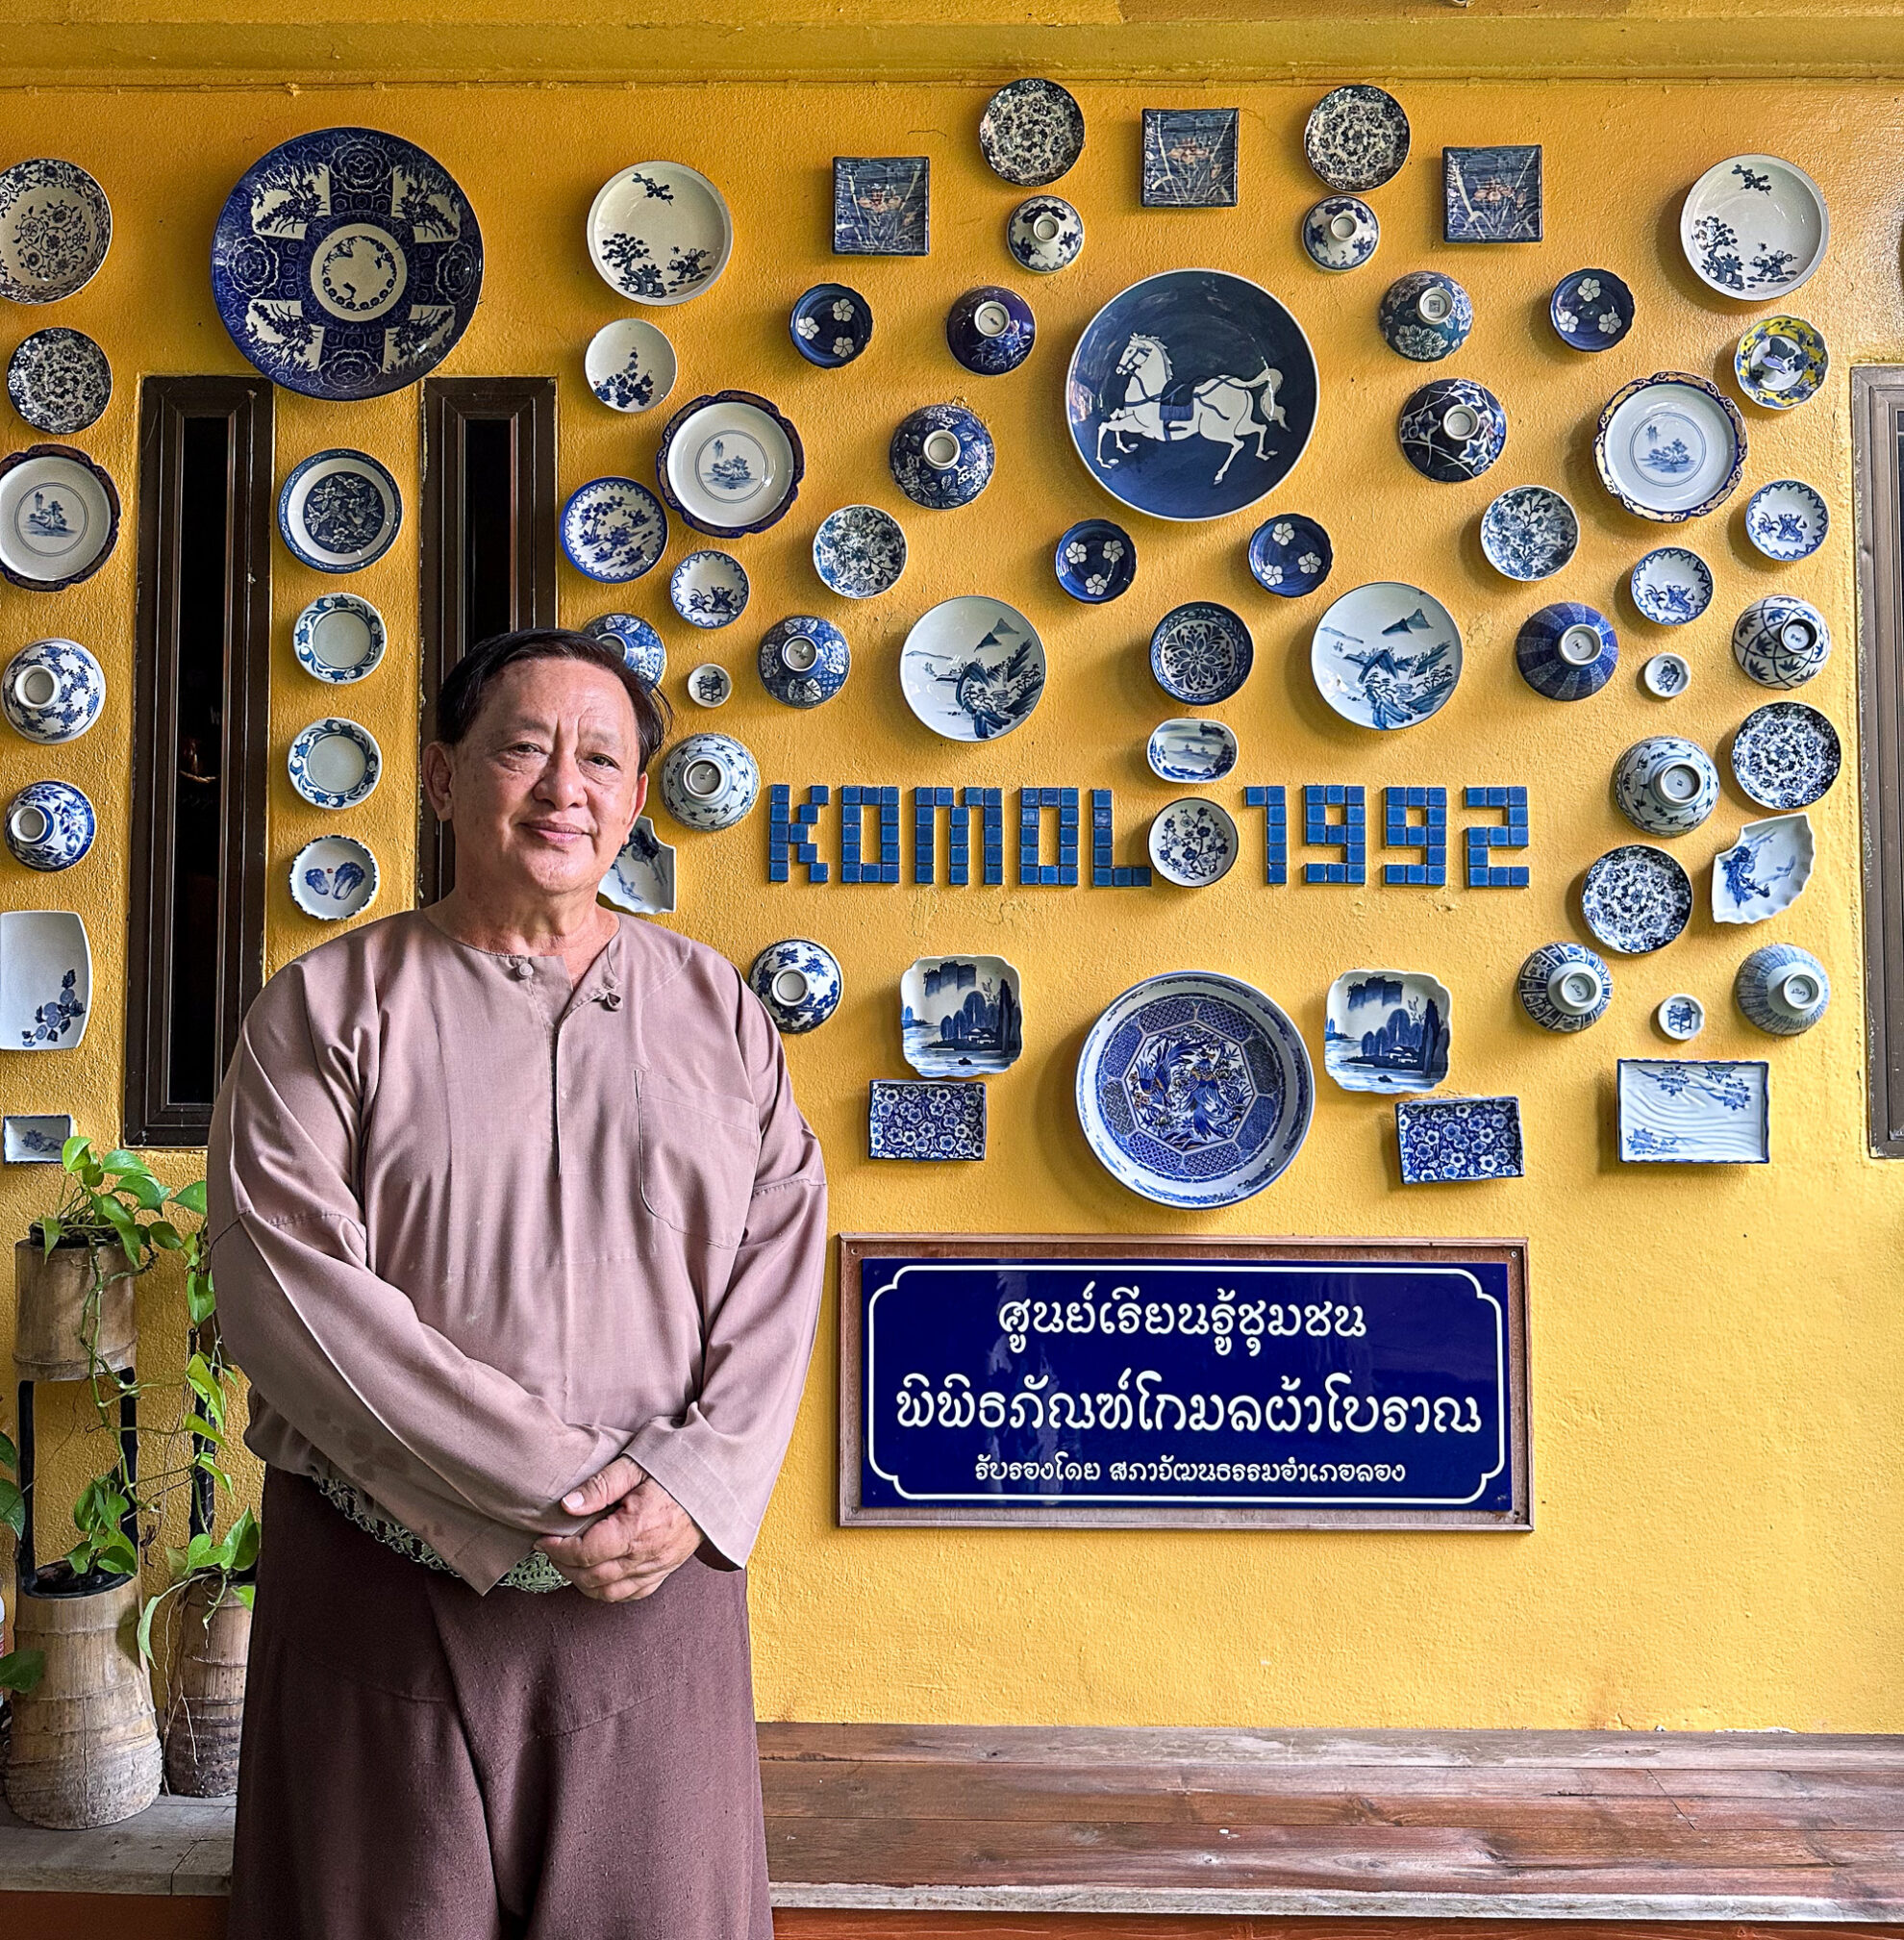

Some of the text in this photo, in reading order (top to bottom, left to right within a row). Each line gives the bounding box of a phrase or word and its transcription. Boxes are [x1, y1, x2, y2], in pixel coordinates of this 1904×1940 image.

[769, 784, 1530, 888] KOMOL 1992
[998, 1280, 1366, 1356] ศูนย์เรียนรู้ชุมชน
[896, 1367, 1482, 1433] พิพิธภัณฑ์โกมลผ้าโบราณ
[975, 1451, 1406, 1482] รับรองโดย สภาวัฒนธรรมอำเภอลอง
